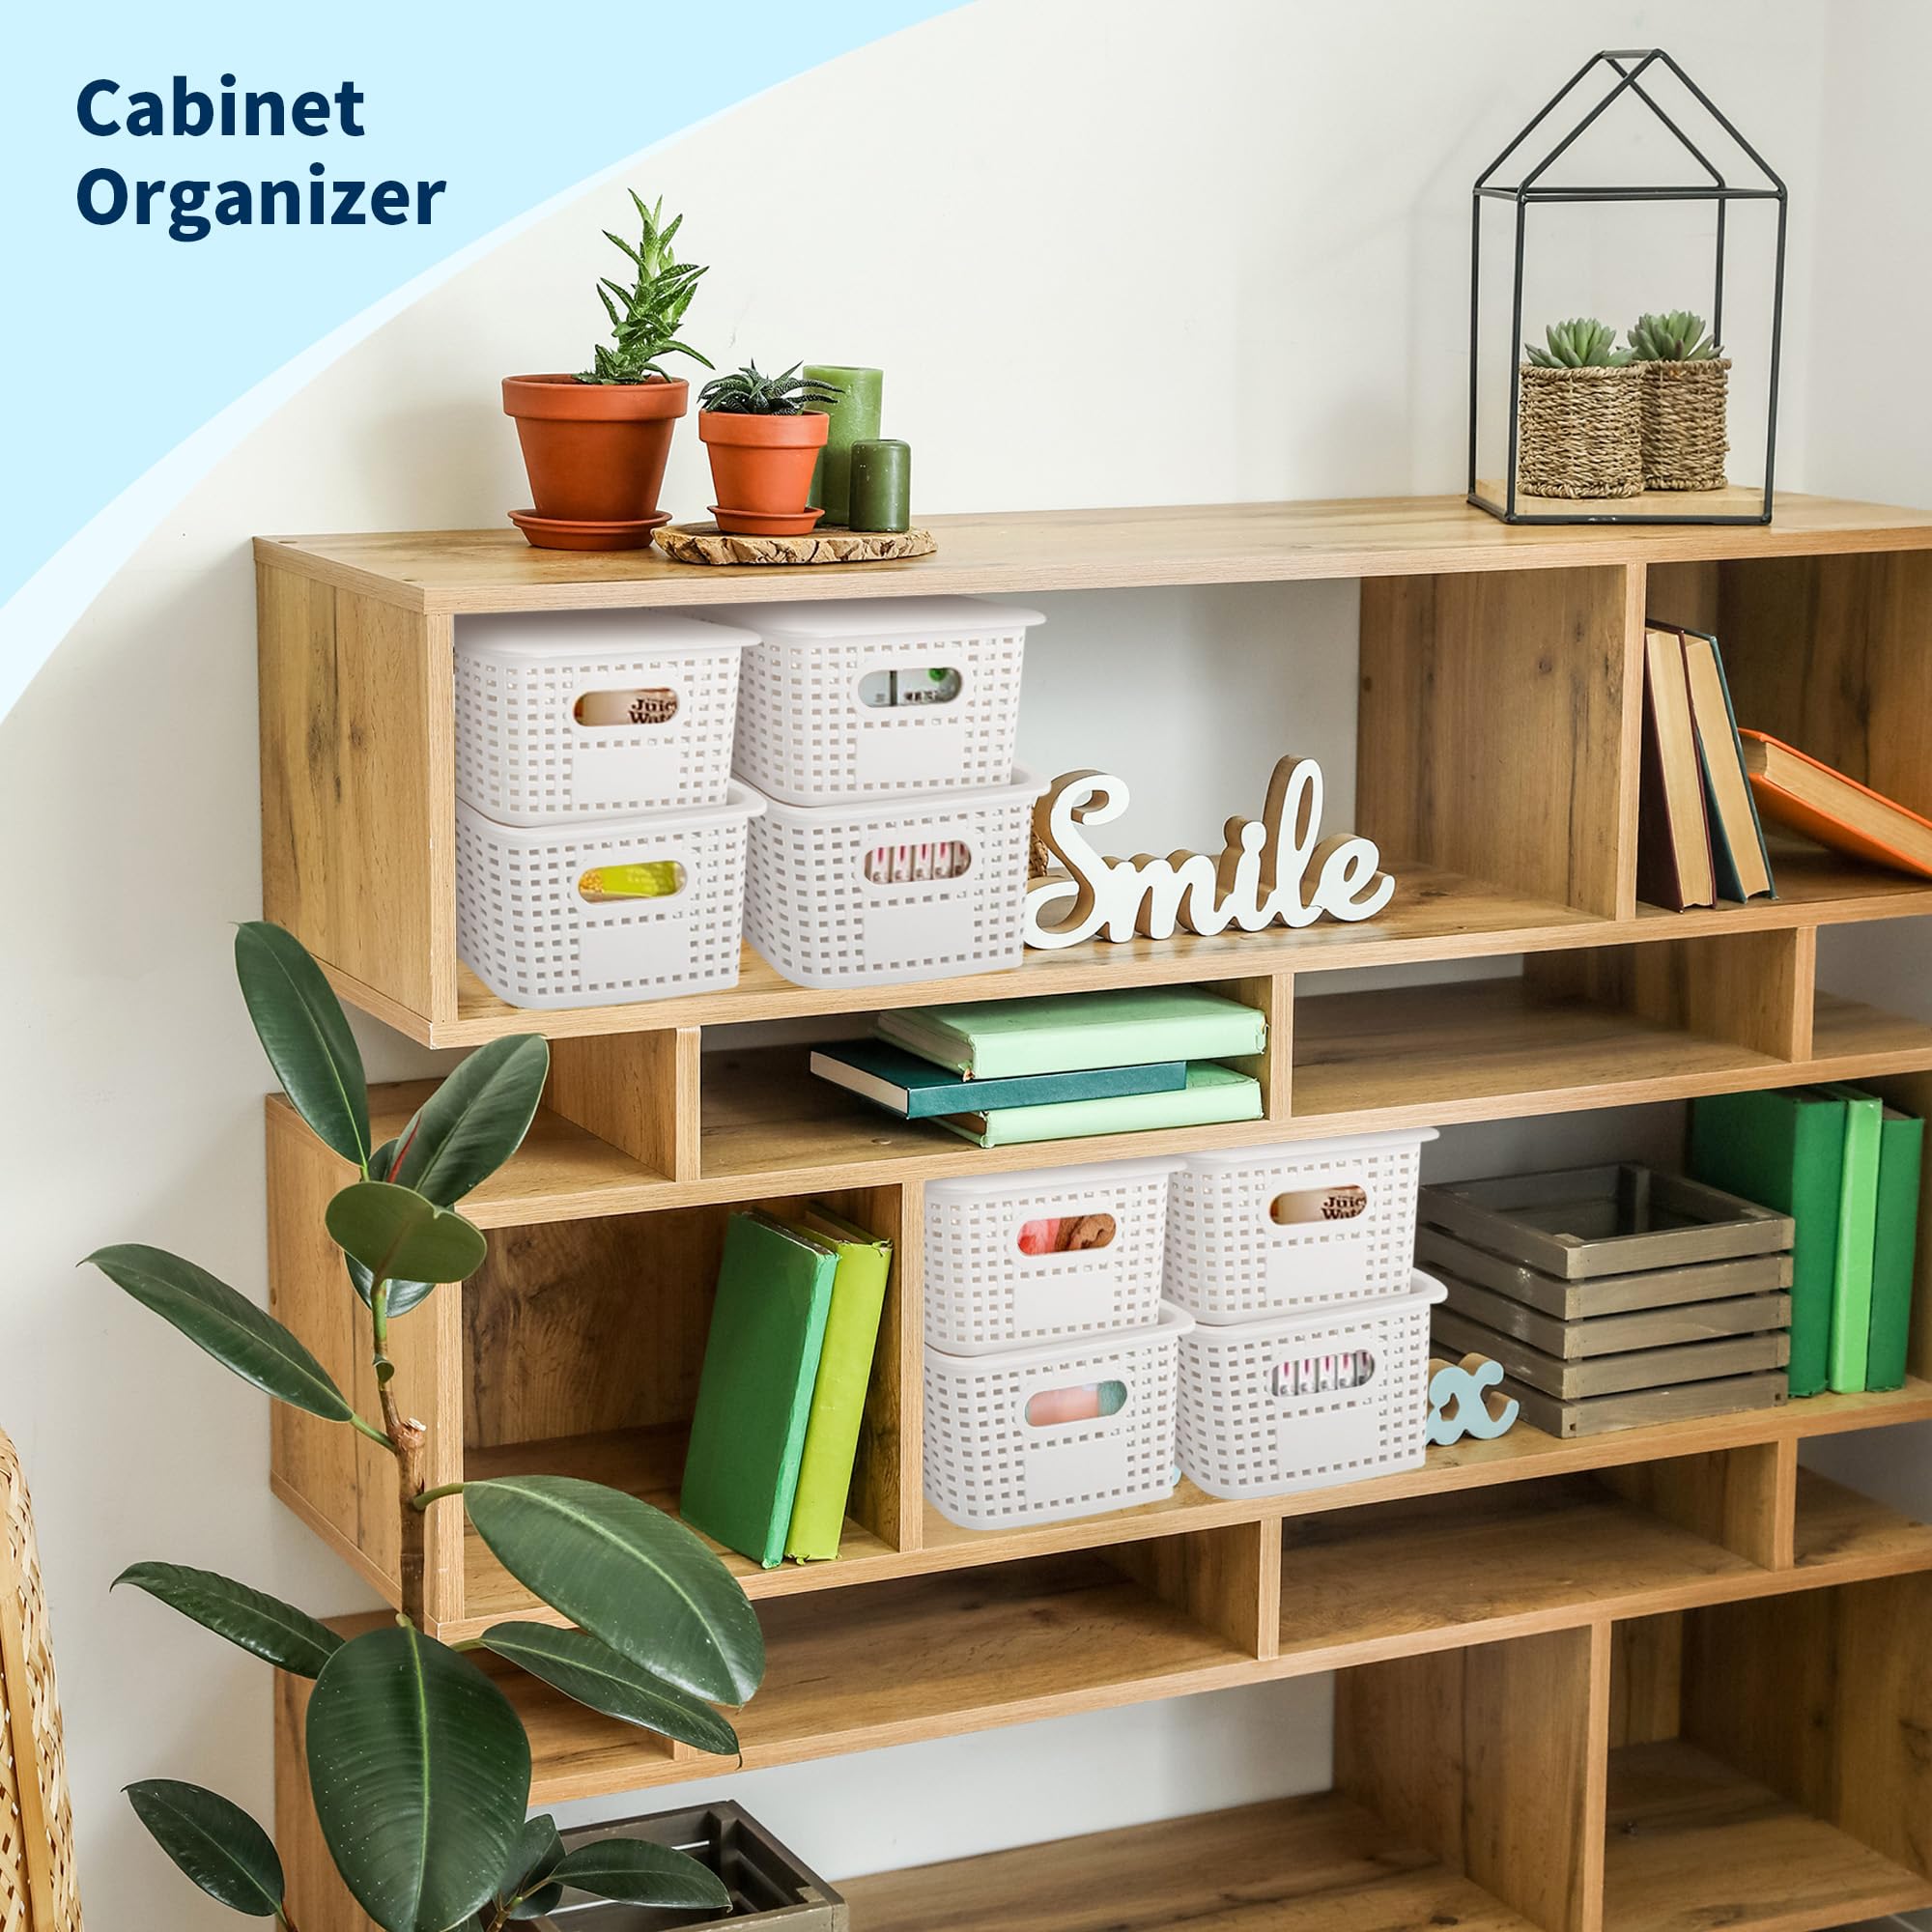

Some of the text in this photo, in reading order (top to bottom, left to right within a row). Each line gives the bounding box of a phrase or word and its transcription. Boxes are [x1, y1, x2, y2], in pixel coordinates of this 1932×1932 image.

[631, 698, 677, 712] Juic
[1024, 757, 1395, 950] Smile
[1323, 1196, 1367, 1208] Juic
